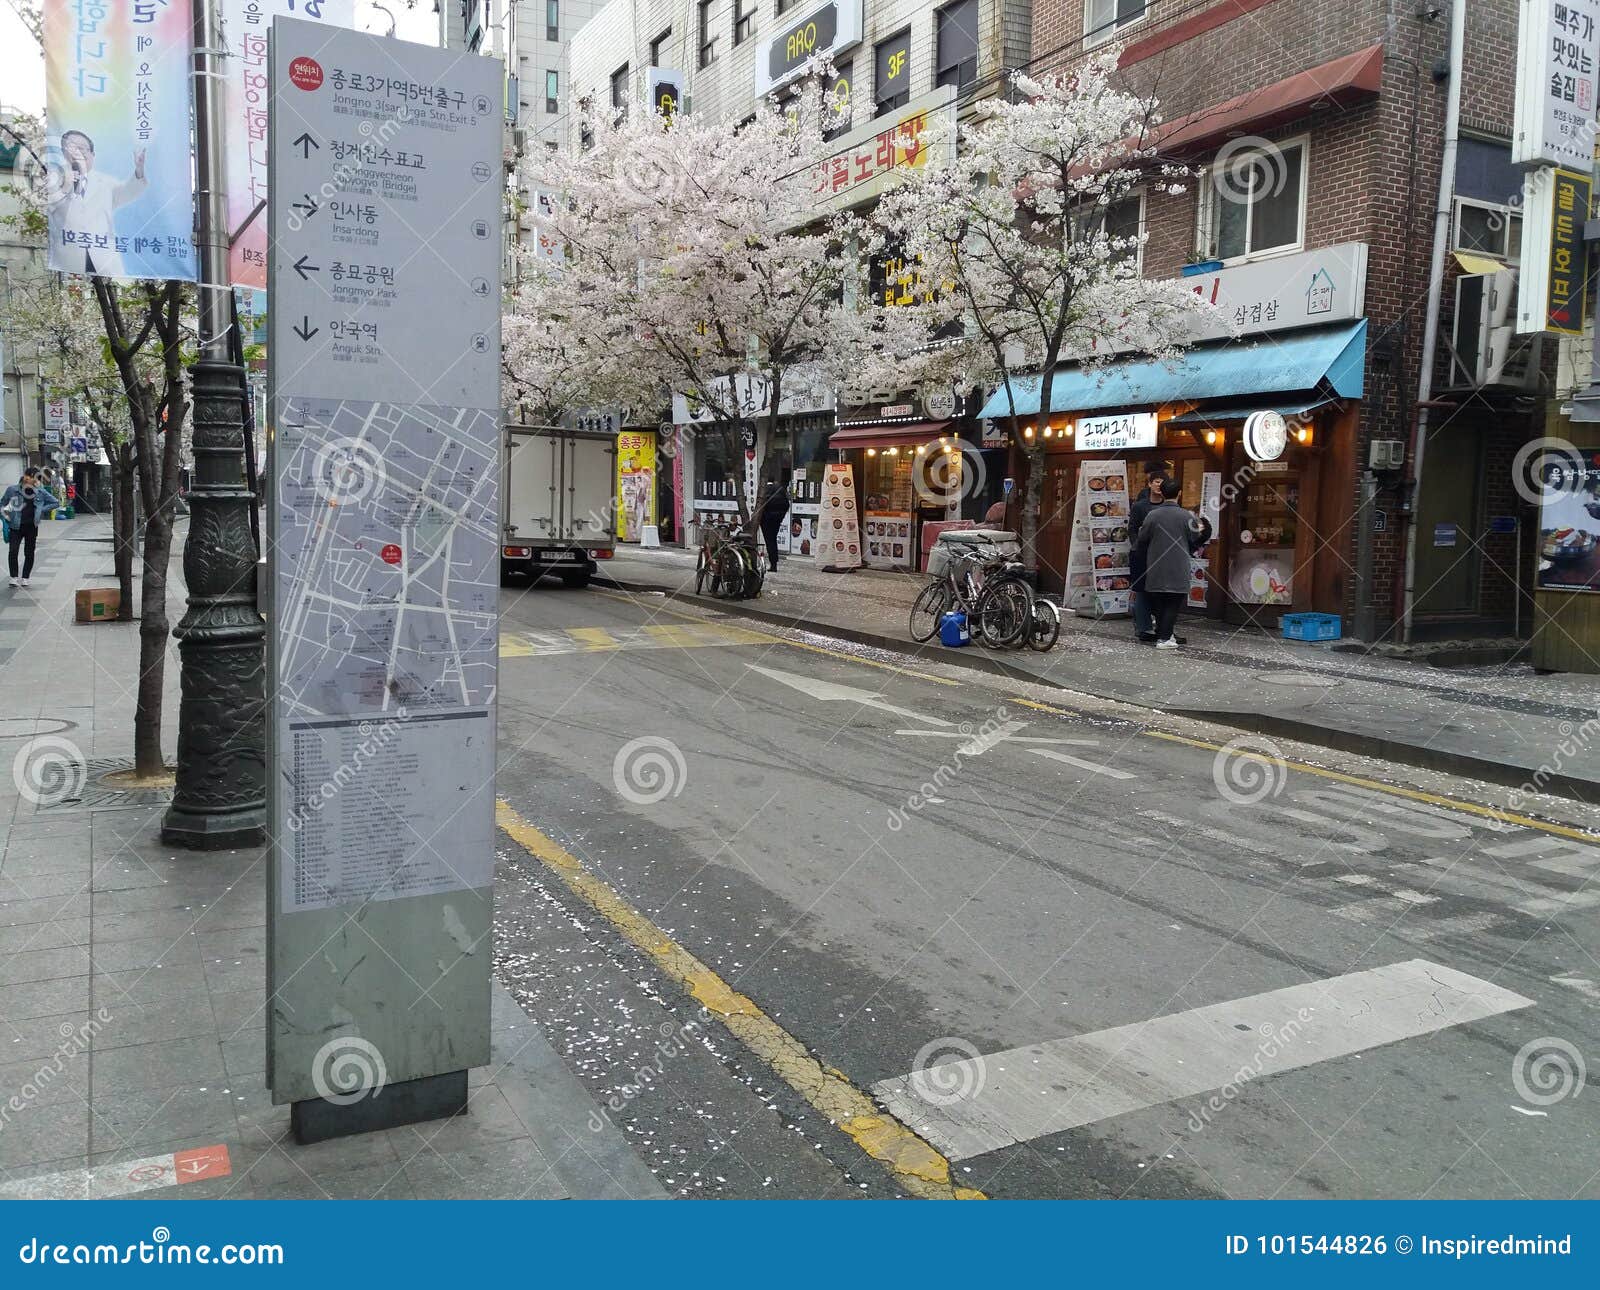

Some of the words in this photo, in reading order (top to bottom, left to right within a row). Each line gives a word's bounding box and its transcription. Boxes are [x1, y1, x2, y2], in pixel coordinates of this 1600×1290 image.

[1554, 4, 1594, 42] 맥주가
[787, 22, 816, 62] ARQ
[887, 49, 906, 80] 3F
[1552, 37, 1592, 74] 맛있는
[294, 64, 319, 77] 현위치
[330, 69, 467, 110] 종로3가역5번출구
[1551, 72, 1576, 103] 술집
[333, 93, 372, 108] Jongno
[470, 116, 477, 126] 5
[330, 140, 427, 170] 청계천수표교
[333, 174, 378, 188] upyogyo
[382, 179, 417, 195] (Bridge)
[330, 201, 379, 224] 인사동
[333, 223, 379, 240] Insa-dong
[329, 261, 394, 286] 종묘공원
[332, 284, 374, 298] Jongmyo
[377, 288, 398, 299] Park
[1232, 299, 1280, 326] 삼겹살
[329, 320, 377, 342] 안국역
[332, 342, 362, 354] Anguk
[1083, 416, 1136, 440] 그때그집
[620, 434, 653, 450] 홍콩가
